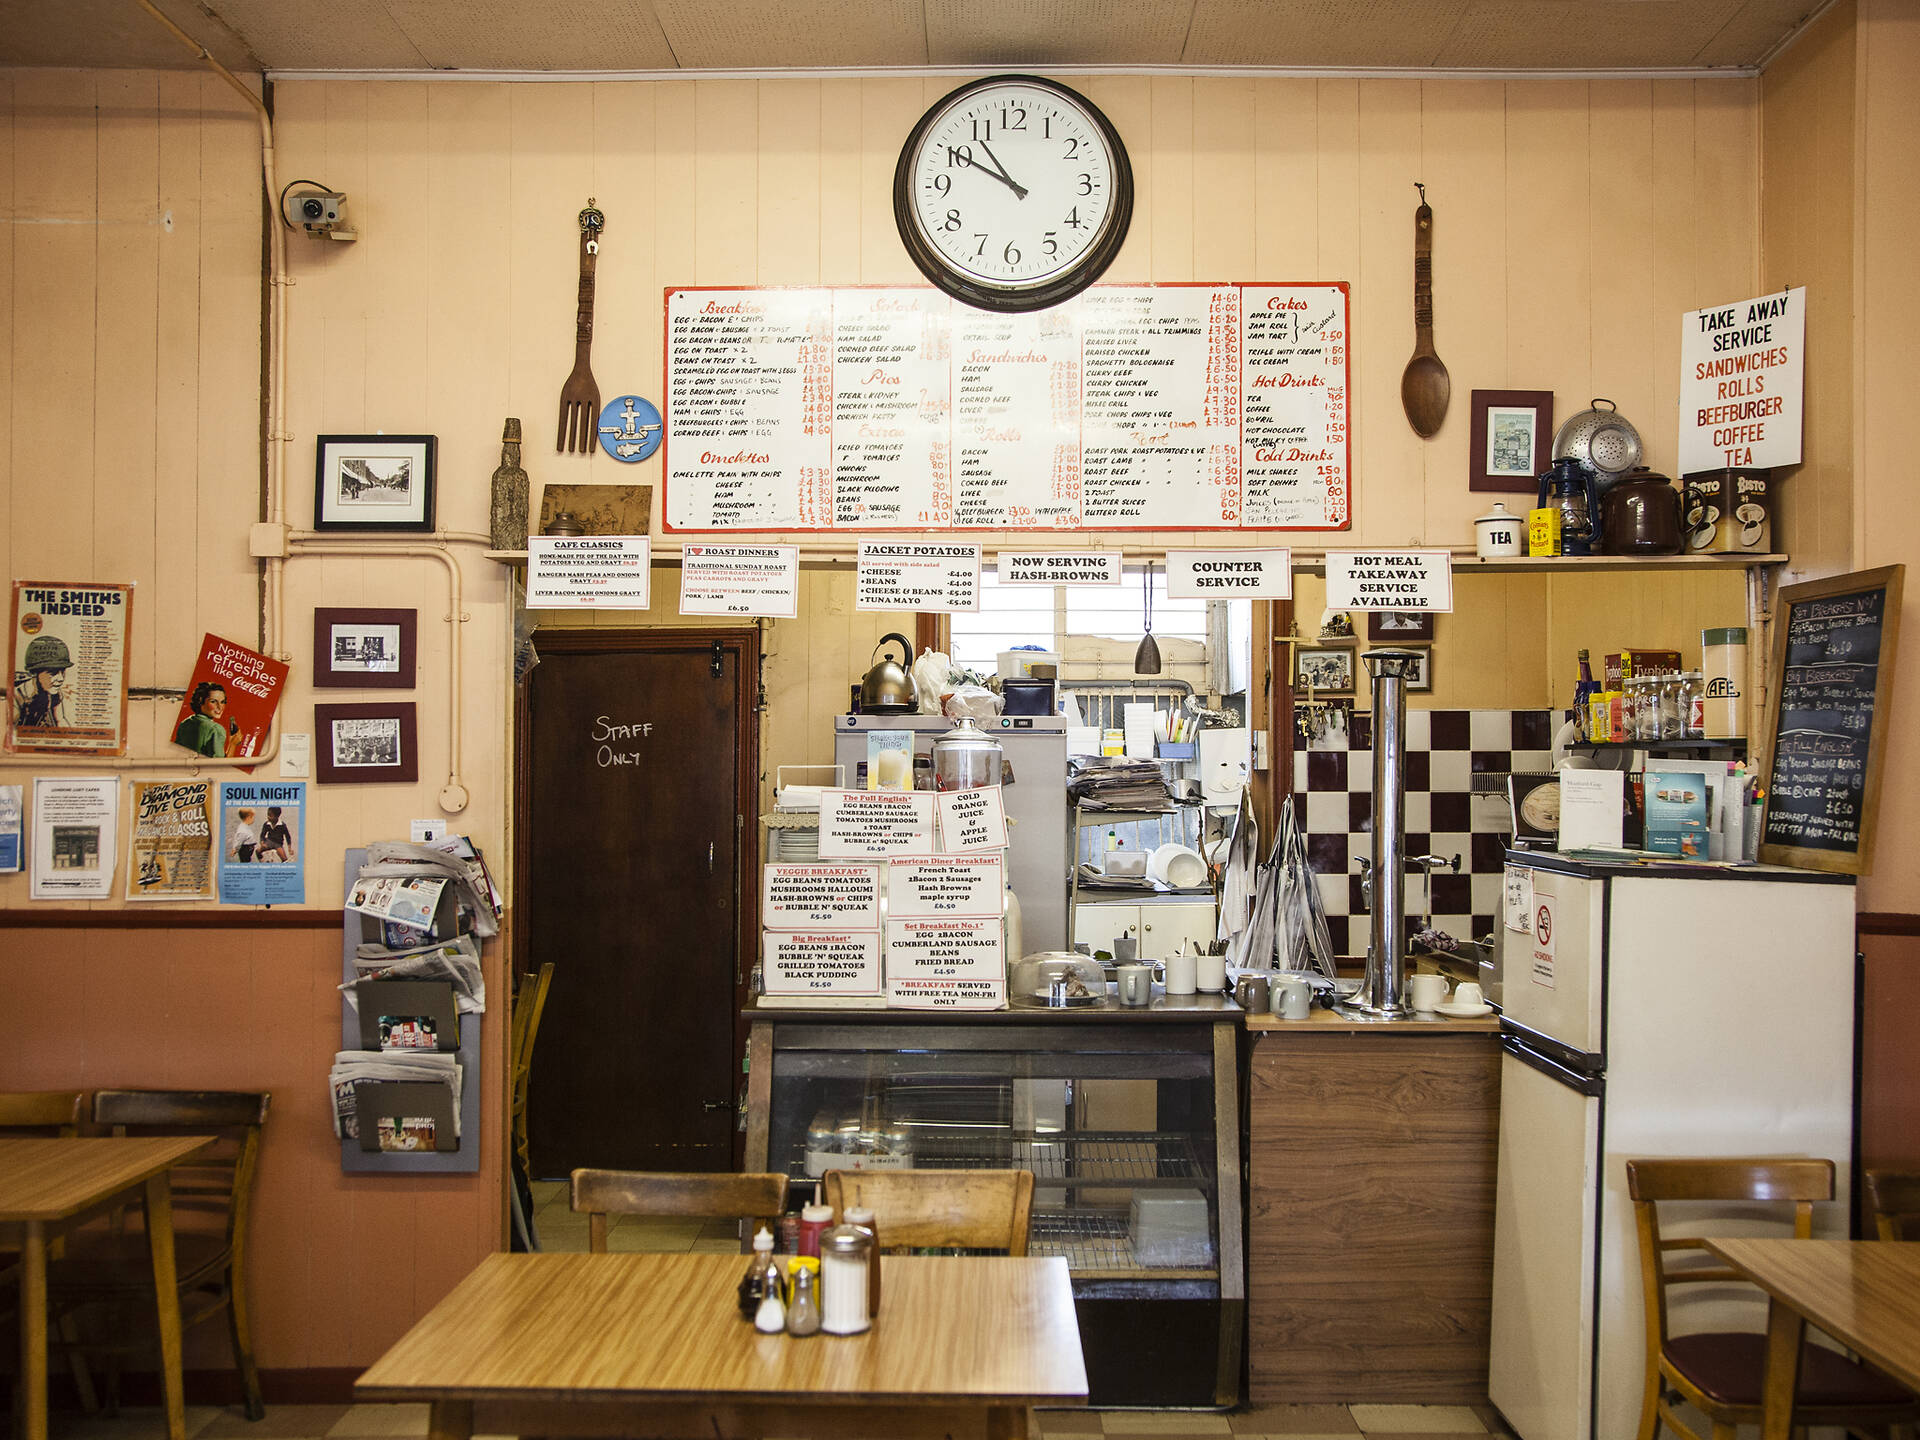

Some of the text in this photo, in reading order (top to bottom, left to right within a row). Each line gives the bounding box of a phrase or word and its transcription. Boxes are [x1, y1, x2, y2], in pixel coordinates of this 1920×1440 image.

[1000, 108, 1027, 131] 12
[970, 119, 992, 141] 11
[1042, 117, 1052, 139] 1
[1063, 139, 1079, 160] 2
[947, 146, 972, 168] 10
[934, 174, 952, 199] 9
[1076, 174, 1092, 196] 3
[945, 209, 961, 231] 8
[1064, 206, 1080, 228] 4
[974, 233, 988, 256] 7
[1042, 232, 1058, 254] 5
[1004, 240, 1021, 265] 6
[1267, 297, 1308, 310] Cakes
[1699, 297, 1788, 332] TAKE AWAY
[1713, 324, 1772, 352] SERVICE
[837, 355, 901, 363] CHICKEN SALAD
[1696, 347, 1788, 380] SANDWICHES
[1252, 372, 1326, 388] Hot Drinks
[1718, 376, 1764, 400] ROLLS
[1698, 397, 1782, 427] BEEFBURGER
[1713, 423, 1764, 447] COFFEE
[700, 451, 770, 464] Omelettes
[1255, 448, 1334, 462] Cold Drinks
[1725, 447, 1752, 467] TEA
[1490, 532, 1512, 545] TEA
[738, 549, 779, 557] DINNERS
[864, 546, 975, 556] JACKET POTATOES
[1012, 557, 1106, 567] NOW SERVING
[1192, 562, 1263, 572] COUNTER
[1354, 556, 1422, 566] HOT MEAL
[1010, 571, 1109, 581] HASH-BROWNS
[1196, 577, 1260, 587] SERVICE
[1348, 570, 1428, 580] TAKEAWAY
[1360, 584, 1418, 593] SERVICE
[25, 590, 121, 605] THE SMITHS
[1350, 597, 1428, 607] AVAILABLE
[41, 603, 104, 616] INDEED
[218, 643, 265, 670] Nothing
[207, 651, 277, 686] refreshes
[213, 664, 234, 679] like
[140, 783, 207, 806] DIAMOND
[153, 784, 172, 793] THE
[226, 787, 300, 800] SOUL NIGHT
[957, 793, 980, 801] COLD
[140, 794, 207, 818] JIVE CLUB
[952, 800, 988, 810] ORANGE
[181, 807, 205, 820] ROLL
[958, 810, 984, 818] JUICE
[168, 822, 209, 836] CLASSES
[960, 827, 988, 836] APPLE
[962, 836, 988, 844] JUICE
[792, 935, 806, 943] Big
